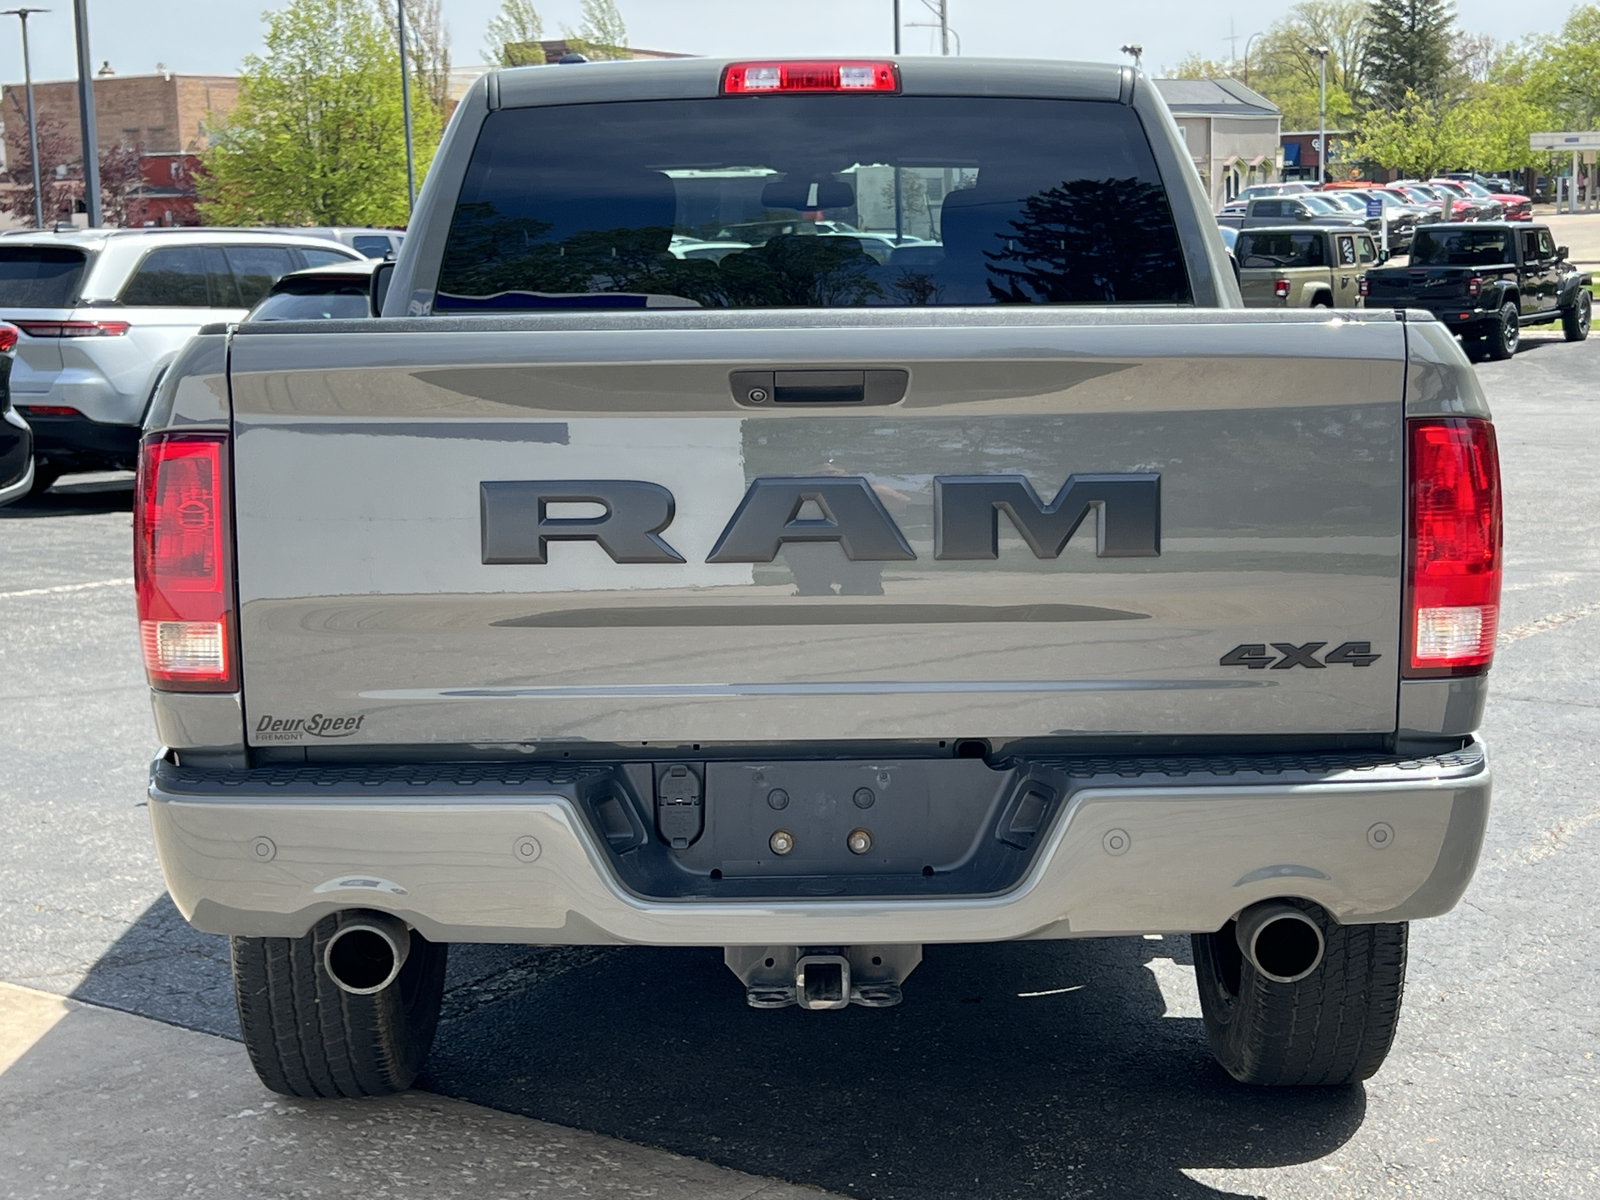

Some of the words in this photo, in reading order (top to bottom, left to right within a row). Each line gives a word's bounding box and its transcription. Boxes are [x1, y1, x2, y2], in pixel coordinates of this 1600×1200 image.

[480, 473, 1161, 565] RAM
[256, 715, 304, 732] Deur
[307, 713, 365, 735] Speet
[255, 733, 304, 741] FREMONT
